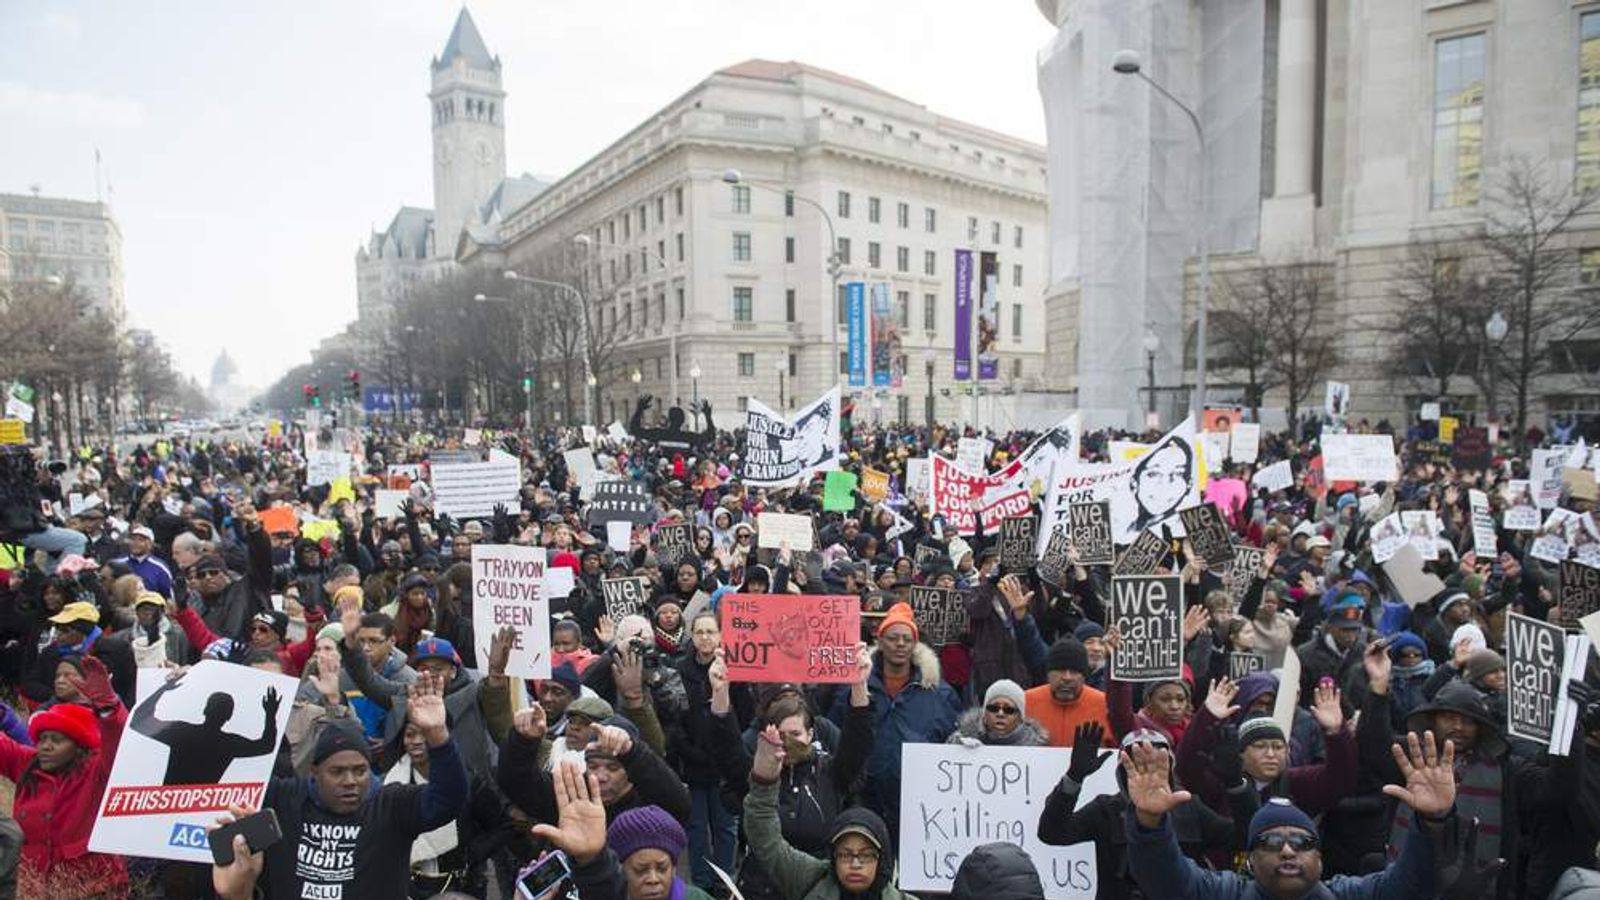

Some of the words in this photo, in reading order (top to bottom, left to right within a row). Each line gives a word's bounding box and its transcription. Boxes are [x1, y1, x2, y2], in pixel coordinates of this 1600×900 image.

[745, 447, 780, 465] JOHN
[938, 478, 971, 498] FOR
[1057, 489, 1093, 505] FOR
[592, 500, 646, 512] MATTER
[478, 558, 544, 578] TRAYVON
[477, 579, 541, 601] COULD'VE
[493, 605, 533, 626] BEEN
[728, 601, 760, 613] THIS
[820, 599, 852, 614] GET
[808, 615, 842, 630] OUT
[1117, 608, 1178, 639] can't
[811, 630, 855, 647] JAIL
[724, 641, 775, 665] NOT
[808, 646, 857, 666] FREE
[1117, 639, 1178, 668] BREATHE
[807, 666, 849, 678] CARD
[937, 759, 1031, 805] STOP!
[107, 786, 262, 812] #THISSTOPSTODAY
[310, 824, 361, 839] KNOW
[920, 799, 1024, 847] Killing
[172, 826, 210, 848] AC
[321, 839, 338, 851] MY
[298, 844, 354, 869] RIGHTS
[305, 884, 340, 899] ACLU
